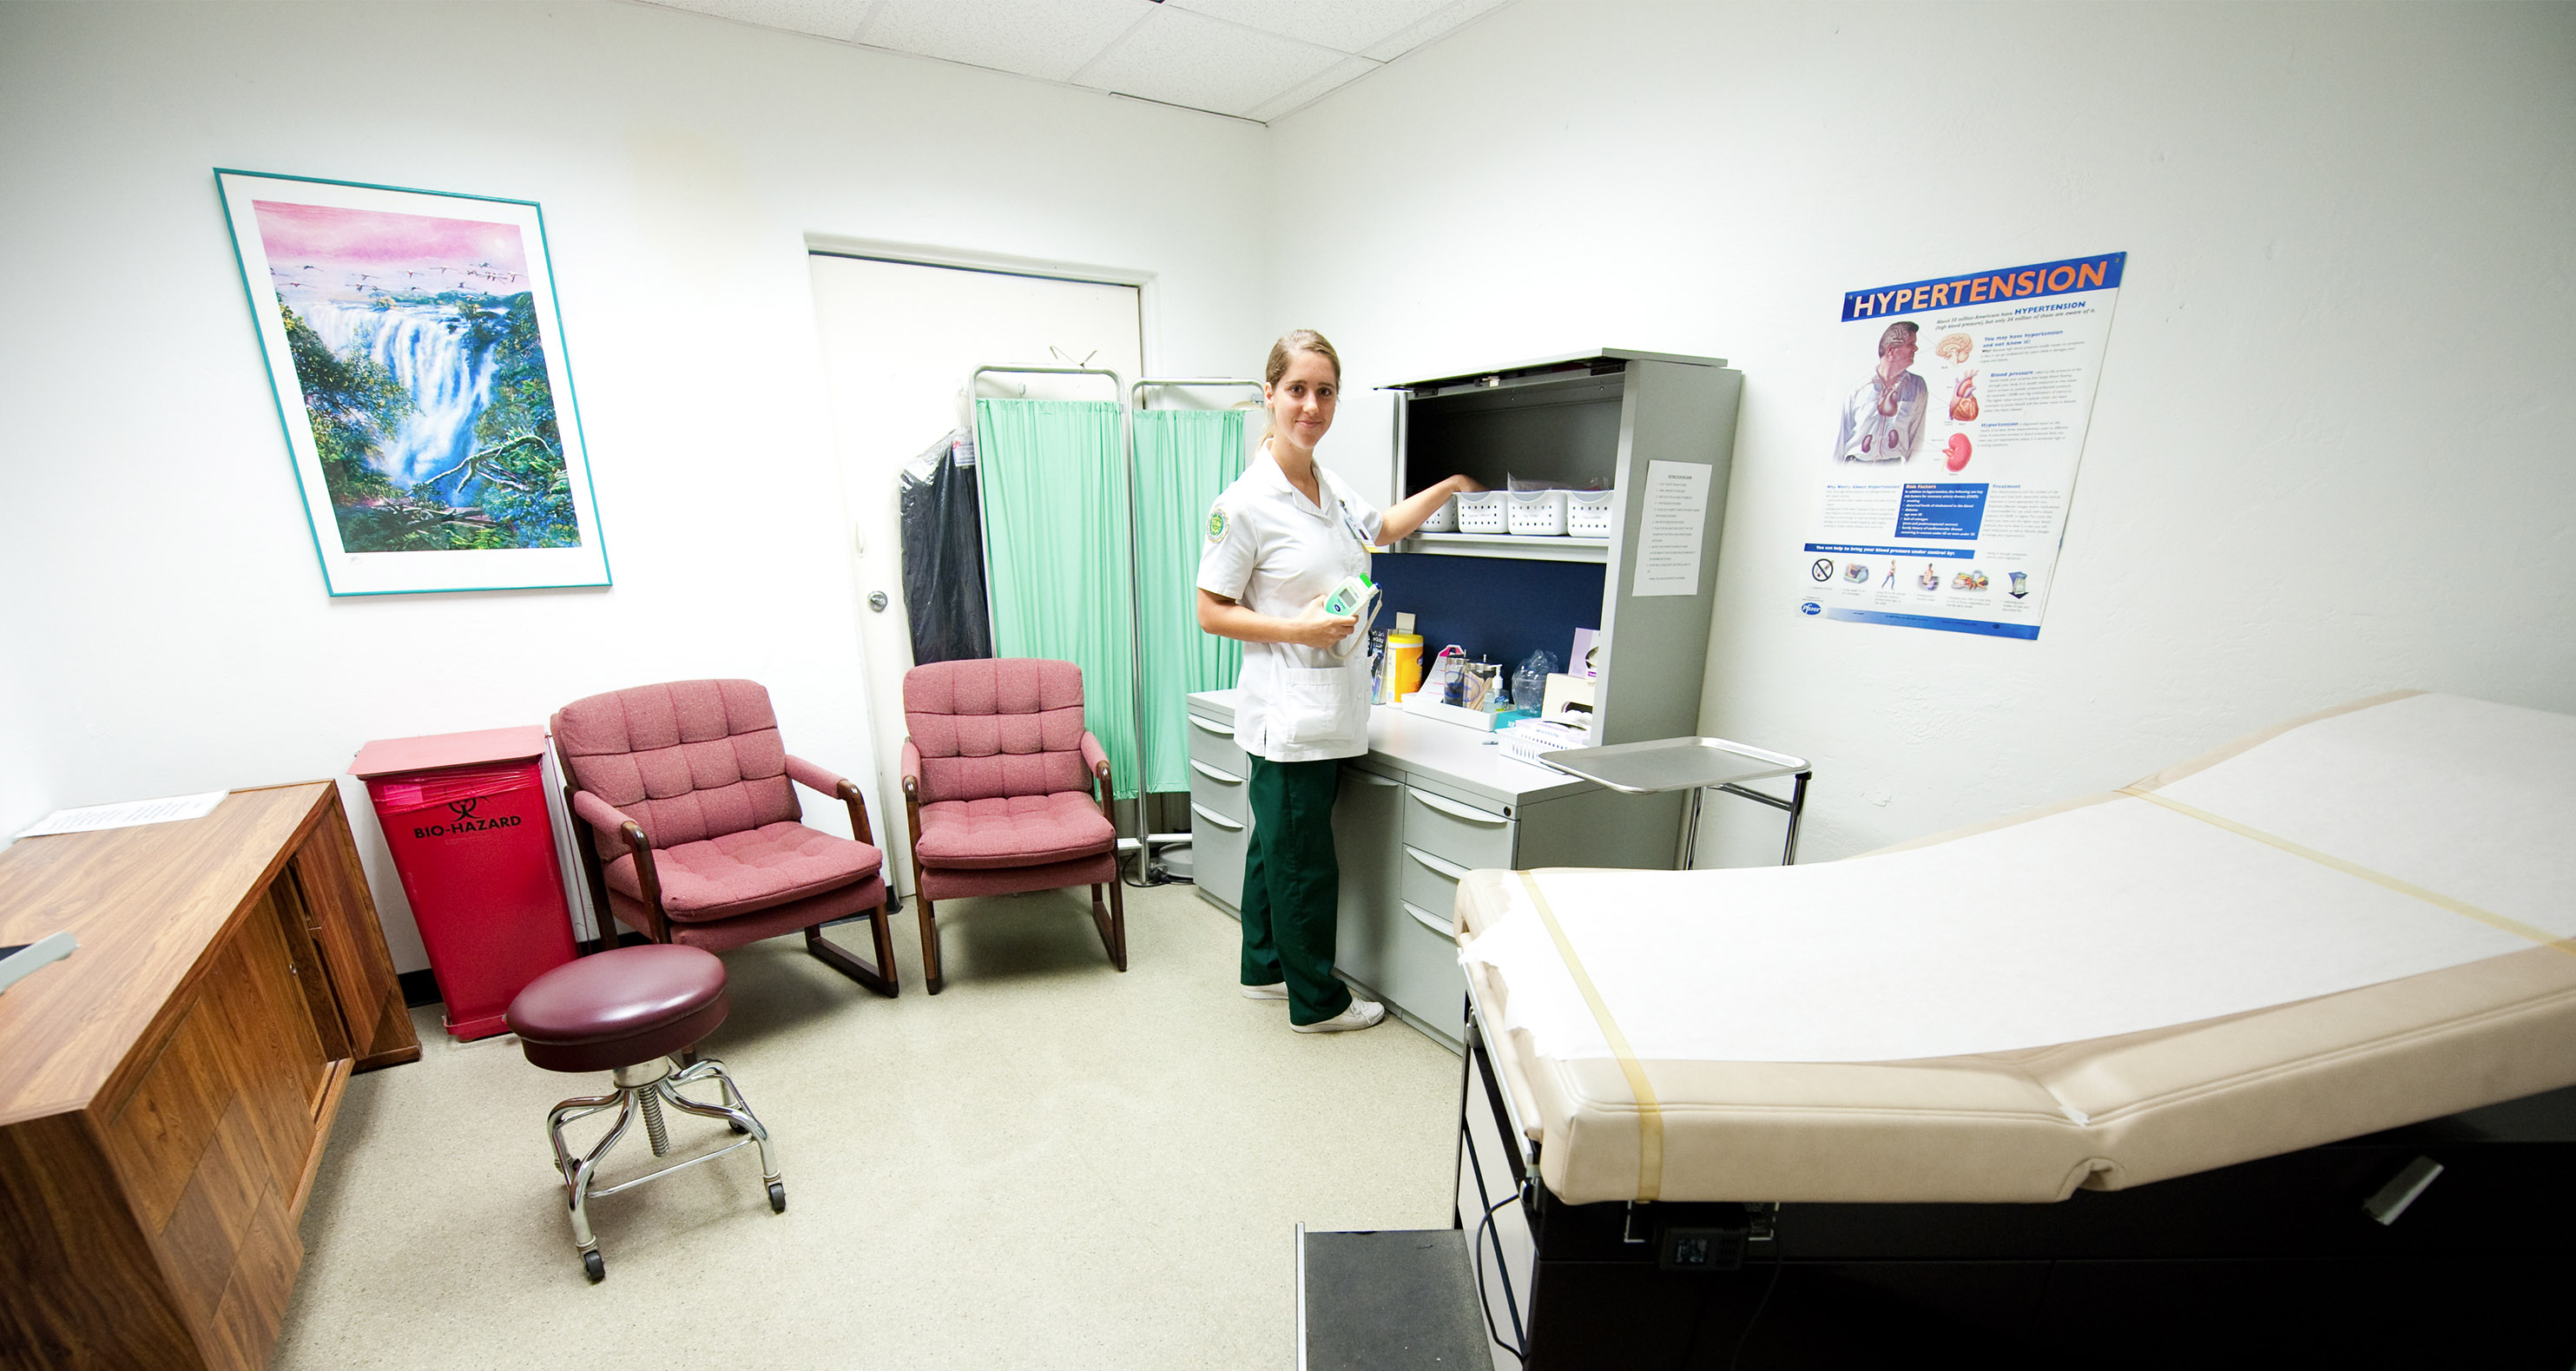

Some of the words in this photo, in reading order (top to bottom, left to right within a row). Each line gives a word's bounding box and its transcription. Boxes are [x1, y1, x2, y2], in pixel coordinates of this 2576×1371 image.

[1853, 260, 2108, 318] HYPERTENSION
[2014, 301, 2086, 315] HYPERTENSION
[2024, 330, 2063, 338] hypertension
[413, 815, 522, 839] BIO-HAZARD
